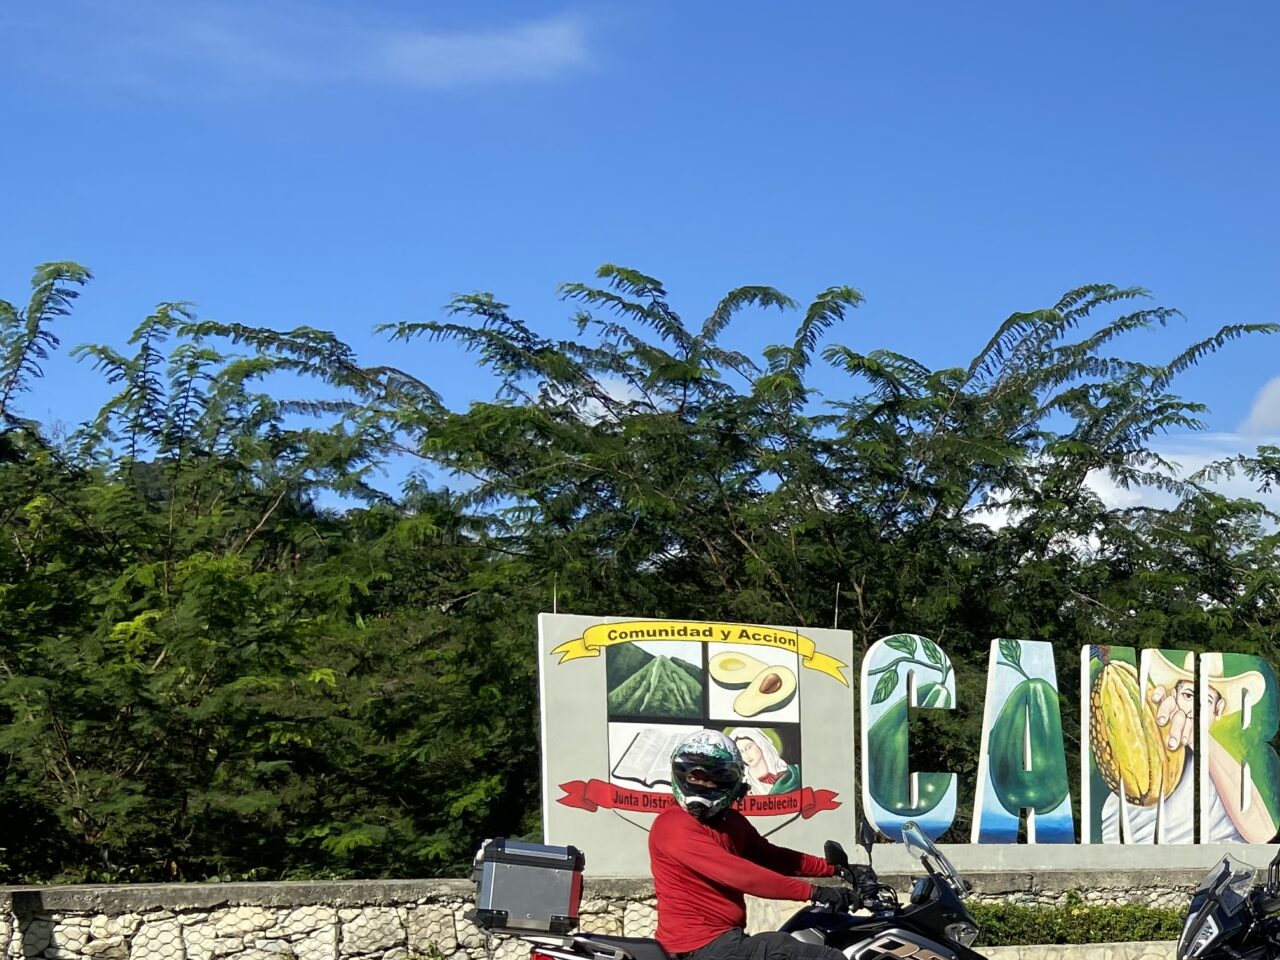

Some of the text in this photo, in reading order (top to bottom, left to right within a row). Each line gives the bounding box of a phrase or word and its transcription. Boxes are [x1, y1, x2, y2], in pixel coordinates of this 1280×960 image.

[607, 626, 796, 647] Comunidad y Accion
[613, 790, 639, 806] Junta
[737, 798, 747, 811] El
[750, 796, 798, 811] Pueblecito
